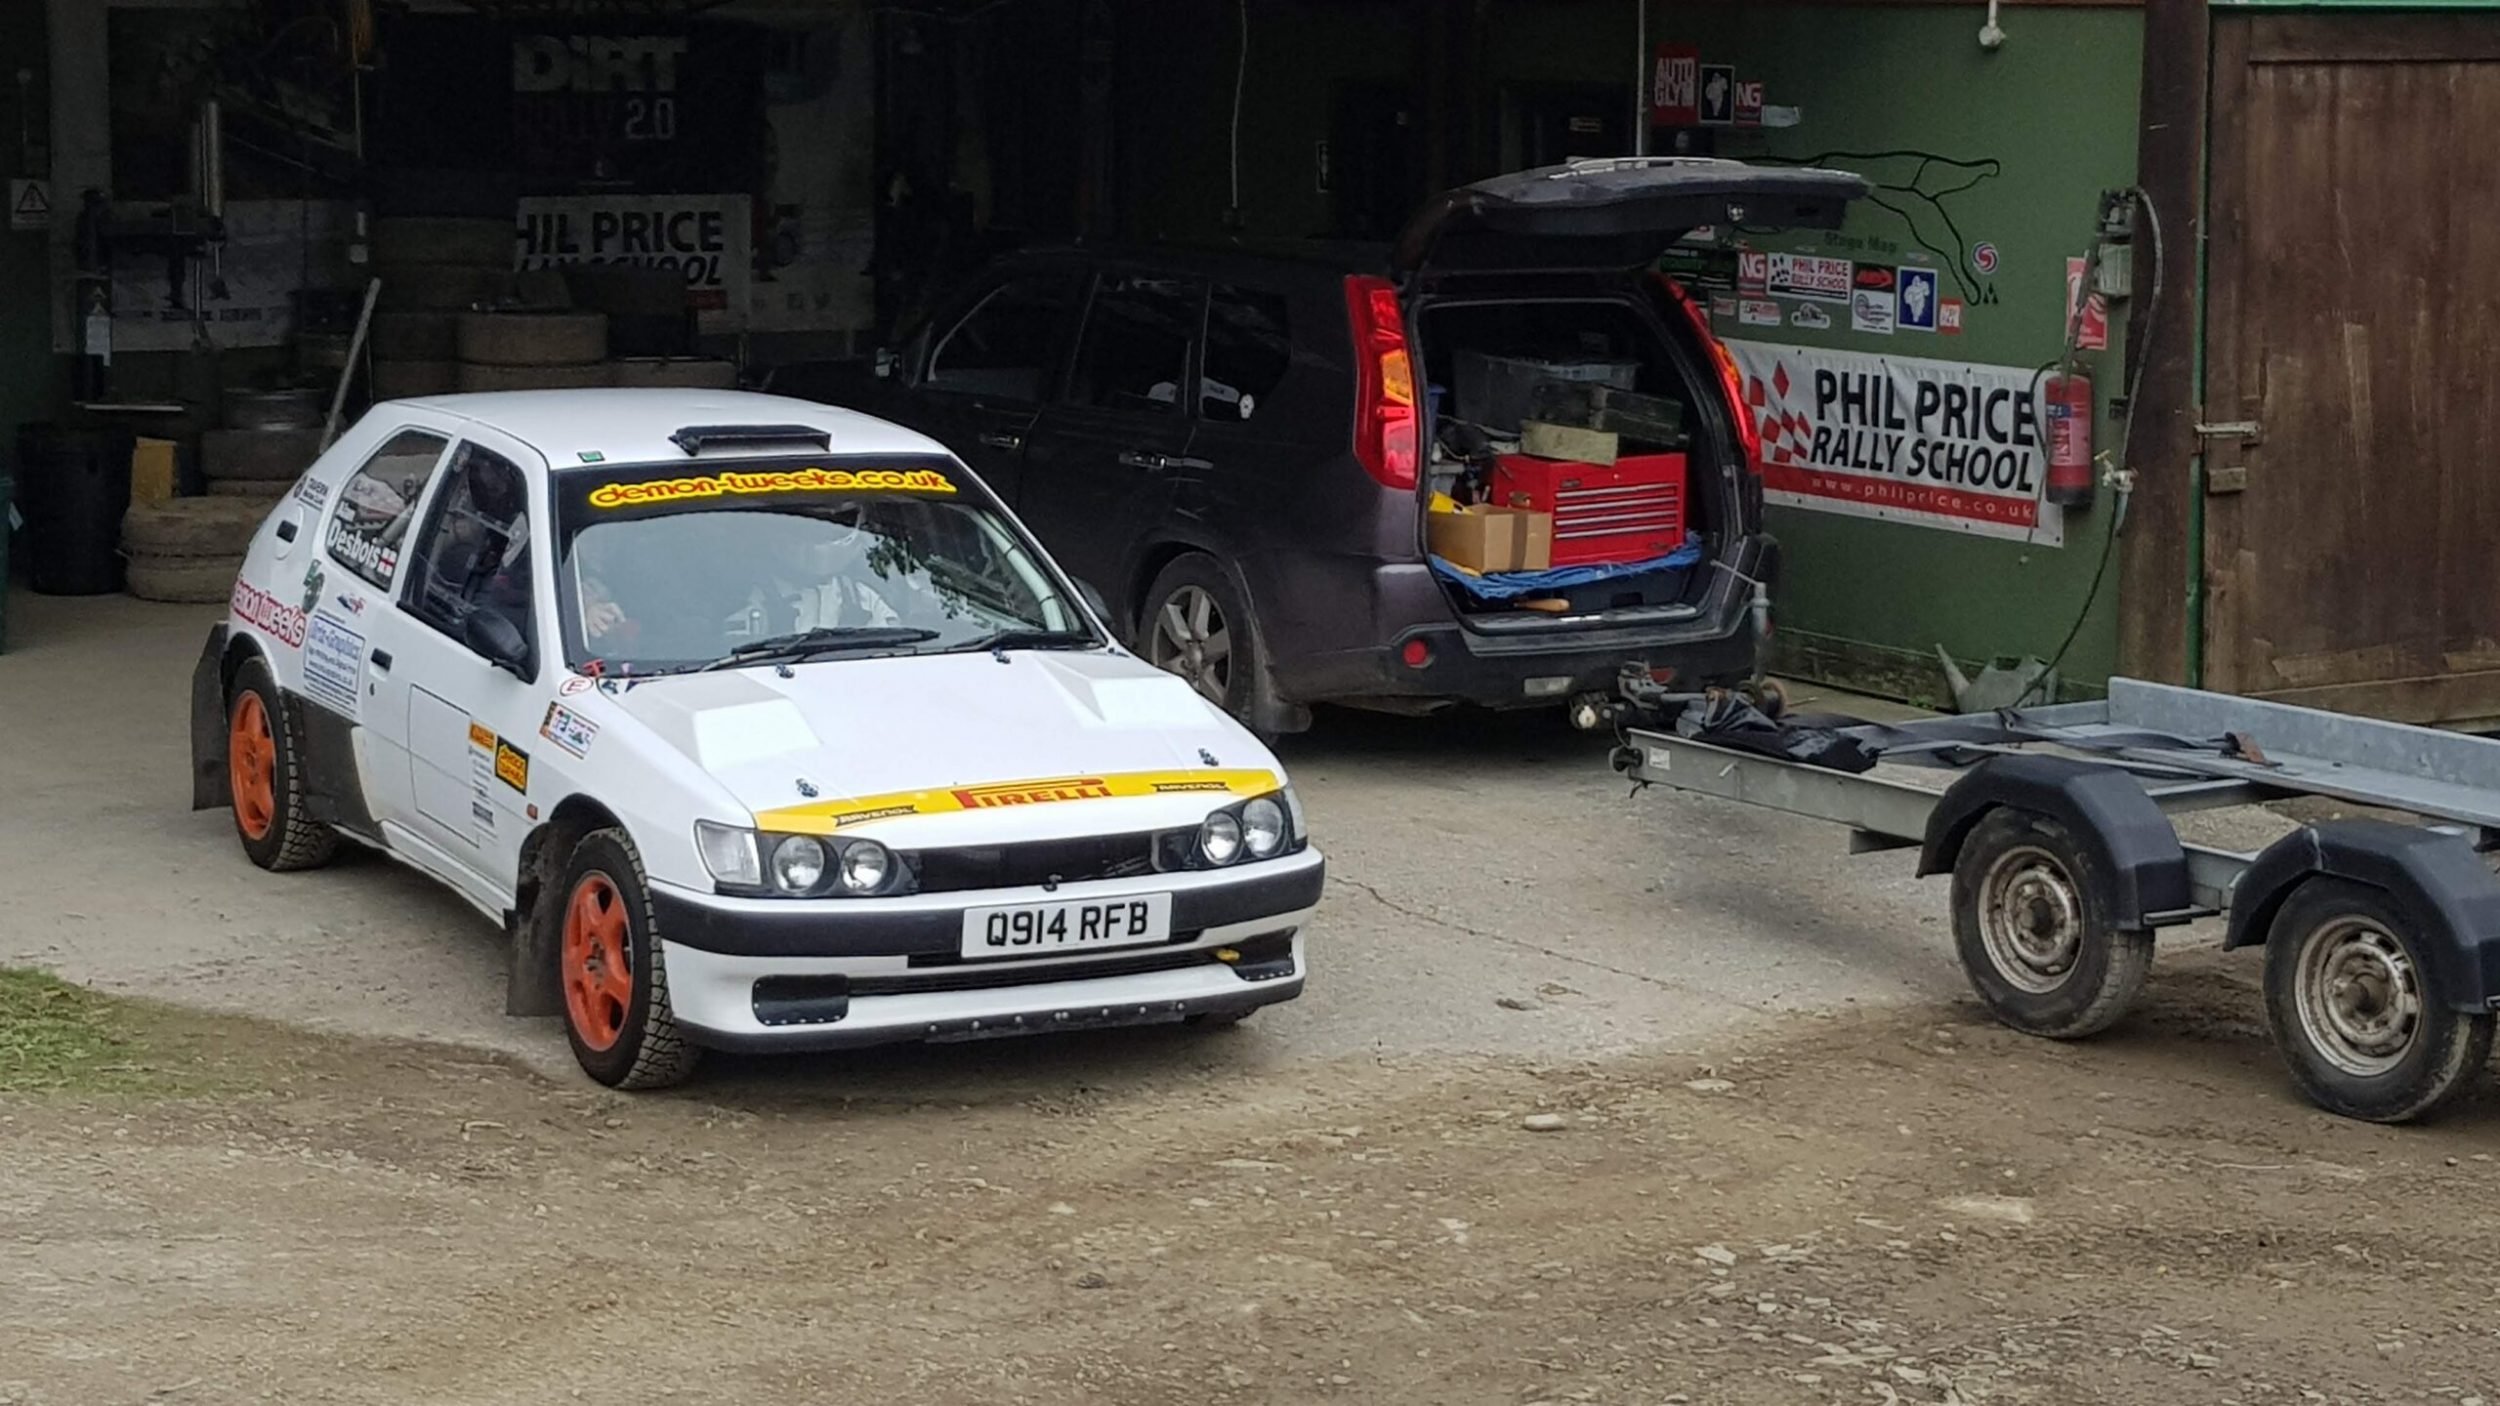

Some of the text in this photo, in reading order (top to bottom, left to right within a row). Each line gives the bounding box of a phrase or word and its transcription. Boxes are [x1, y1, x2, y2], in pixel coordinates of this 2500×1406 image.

[1655, 57, 1696, 80] AUTO
[1736, 82, 1762, 107] NG
[625, 98, 676, 140] 2.0
[516, 212, 723, 253] HIL PRICE
[1739, 253, 1766, 279] NG
[1792, 258, 1815, 273] PHIL
[1818, 260, 1848, 277] PRICE
[1816, 275, 1847, 290] SCHOOL
[1815, 369, 1905, 431] PHIL
[1915, 380, 2035, 447] PRICE
[1810, 425, 1904, 473] RALLY
[1906, 438, 2033, 492] SCHOOL
[593, 470, 954, 505] demon-tweeks.co.uk
[1811, 478, 2033, 520] www.philprice.co.uk
[326, 518, 381, 570] Desbois
[951, 779, 1112, 809] PIRELLI
[986, 901, 1149, 947] Q914 RFB
